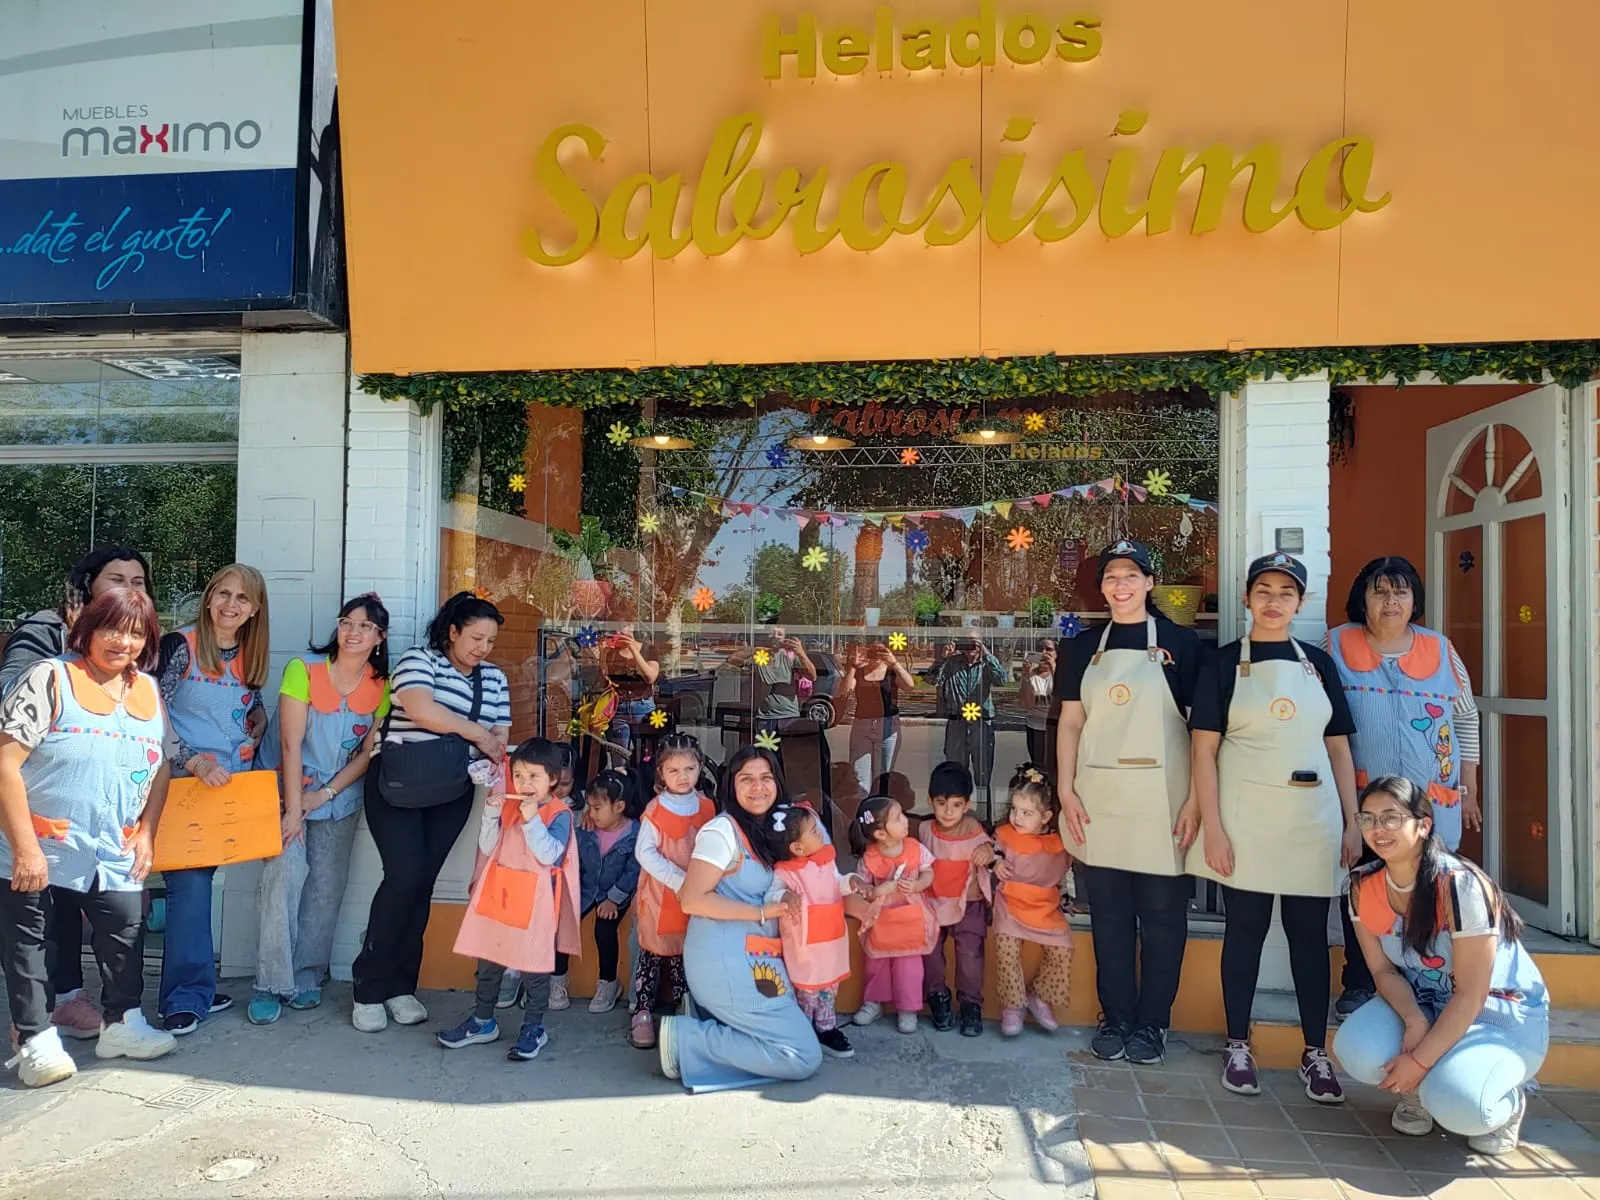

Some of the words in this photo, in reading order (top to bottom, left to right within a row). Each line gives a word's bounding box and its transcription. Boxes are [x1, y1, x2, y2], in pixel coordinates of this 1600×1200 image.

[762, 0, 1103, 80] Helados
[62, 104, 149, 121] MUEBLES
[84, 206, 132, 253] el
[96, 206, 232, 290] gusto!
[1010, 443, 1104, 460] Helados
